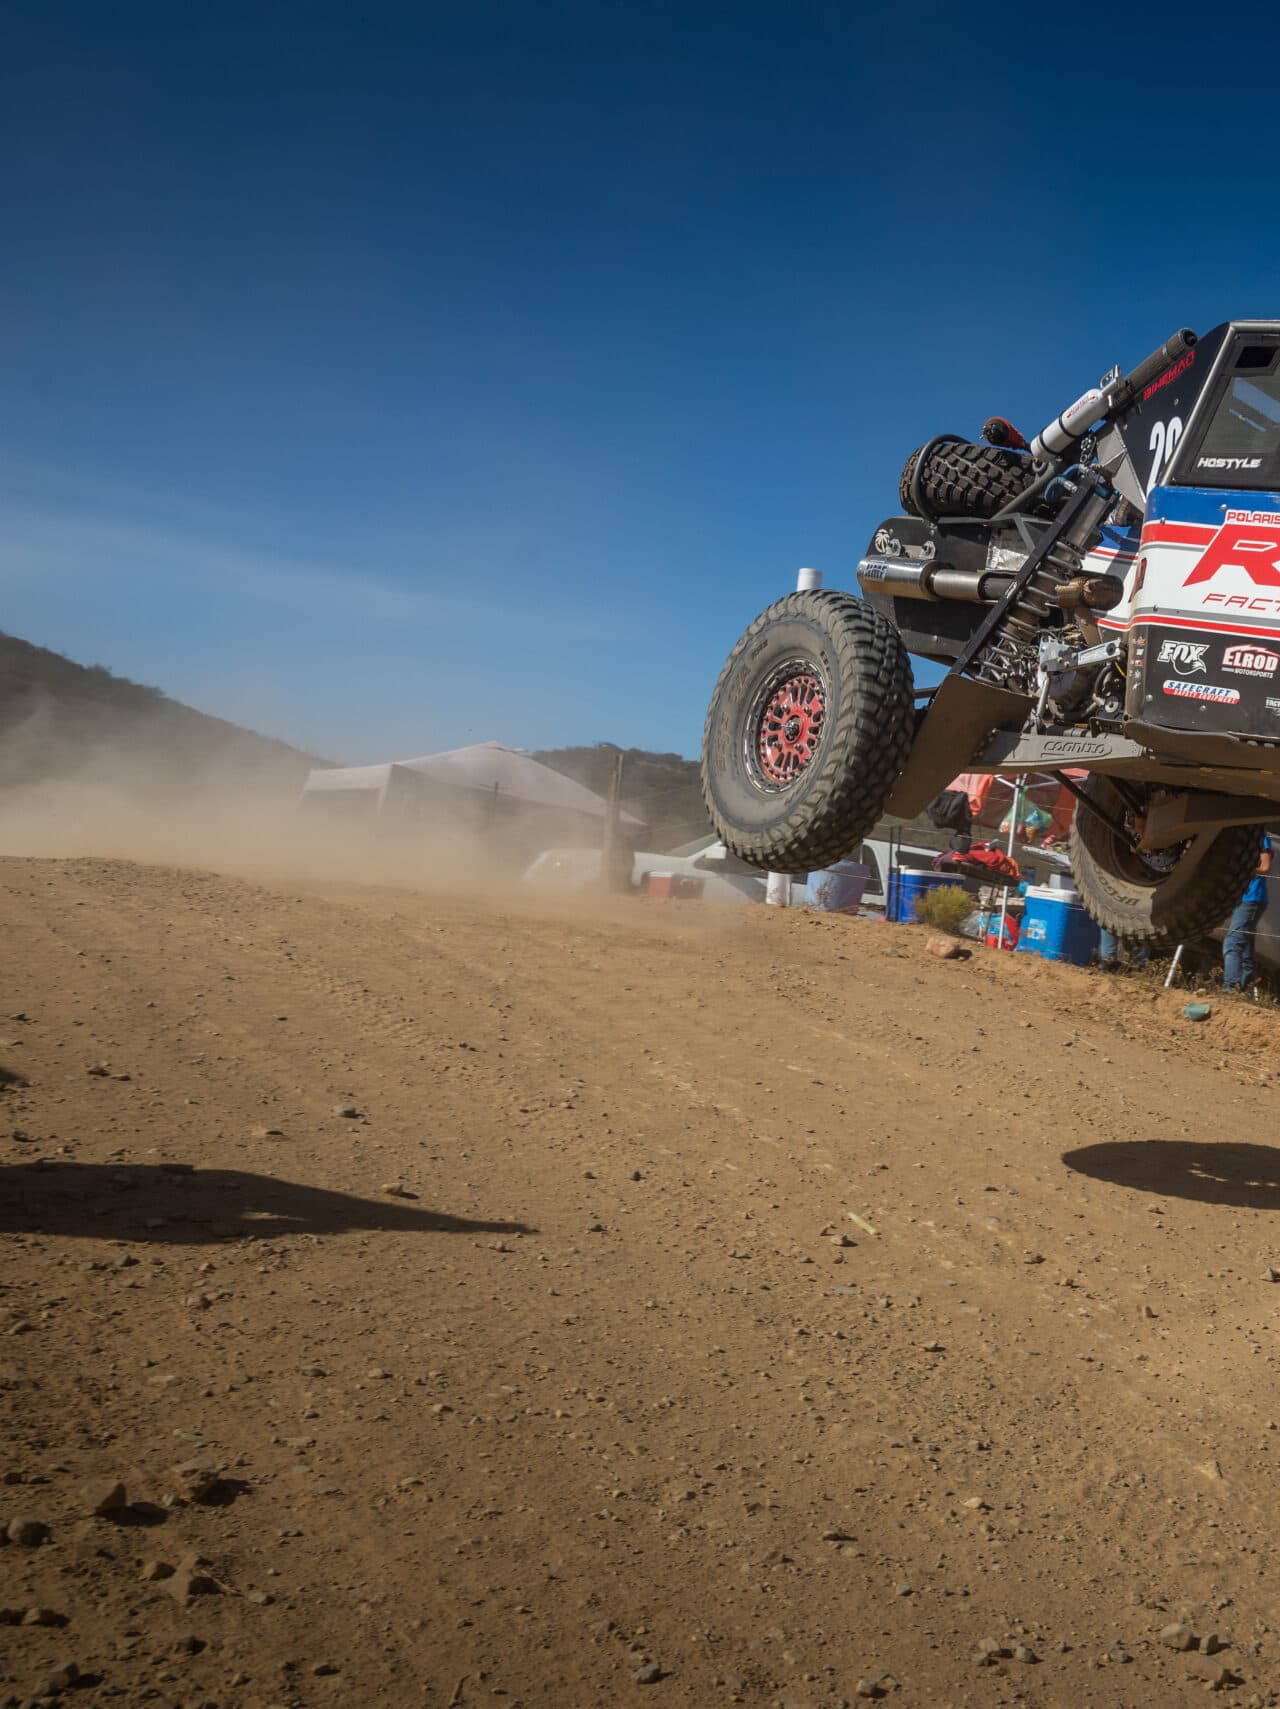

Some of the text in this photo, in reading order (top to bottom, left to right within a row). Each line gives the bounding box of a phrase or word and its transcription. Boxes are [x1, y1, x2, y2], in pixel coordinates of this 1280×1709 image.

[1197, 457, 1263, 469] HOSTYLE
[1157, 640, 1210, 668] FOX
[1221, 646, 1280, 671] ELROD
[1234, 668, 1274, 679] MOTORSPORTS
[1167, 681, 1232, 697] SAFECRAFT
[1044, 741, 1105, 753] COGNITO
